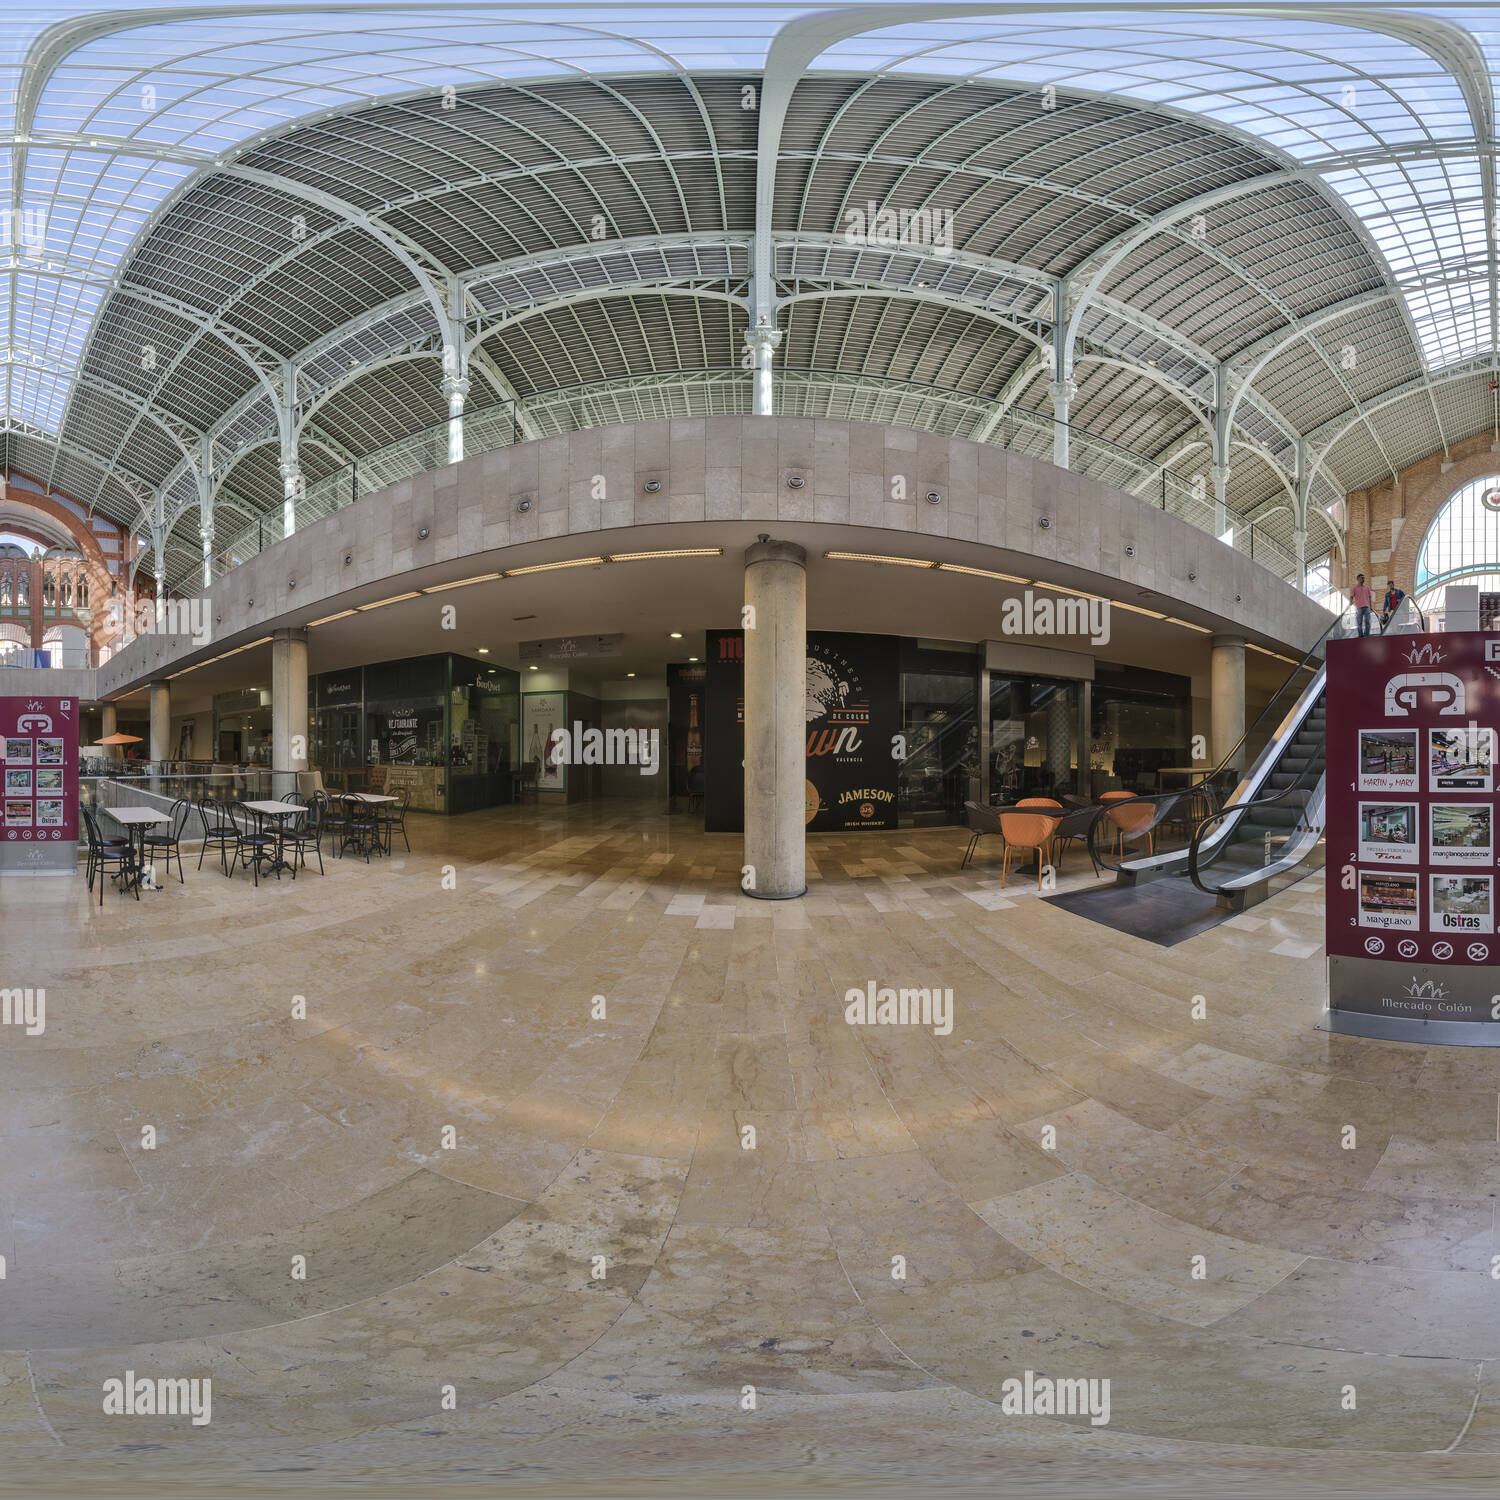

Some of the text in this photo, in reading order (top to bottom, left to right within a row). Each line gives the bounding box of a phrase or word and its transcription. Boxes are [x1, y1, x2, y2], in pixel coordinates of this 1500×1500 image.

[1350, 782, 1355, 791] 1
[1395, 779, 1414, 787] MARY
[838, 789, 893, 804] JAMESON
[1350, 853, 1356, 861] 2
[1350, 918, 1356, 926] 3
[1443, 914, 1480, 927] Ostras
[1382, 998, 1472, 1013] Mercado Colón
